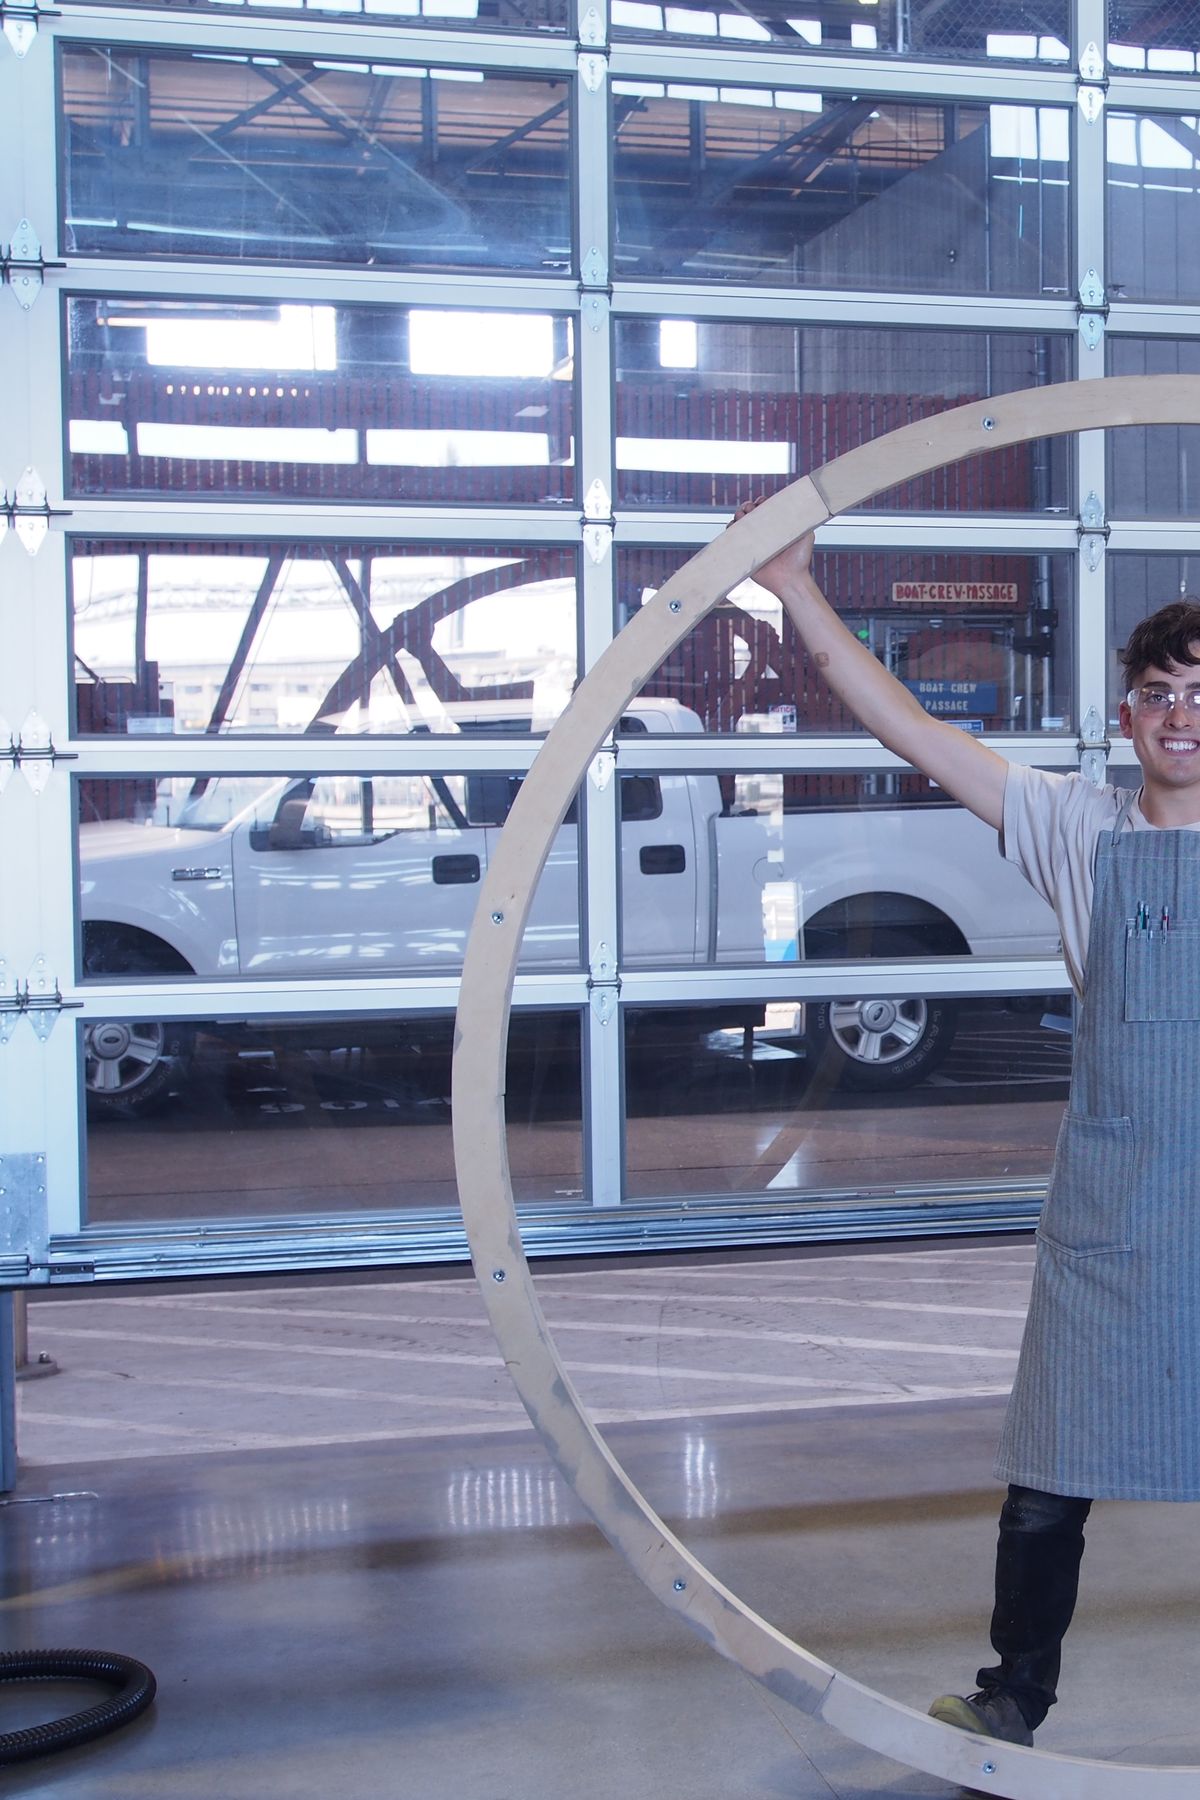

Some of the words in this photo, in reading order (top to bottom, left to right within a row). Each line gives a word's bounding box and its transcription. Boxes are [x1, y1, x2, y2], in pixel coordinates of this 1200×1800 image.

[919, 682, 944, 693] BOAT
[951, 683, 977, 694] CREW
[925, 700, 969, 711] PASSAGE
